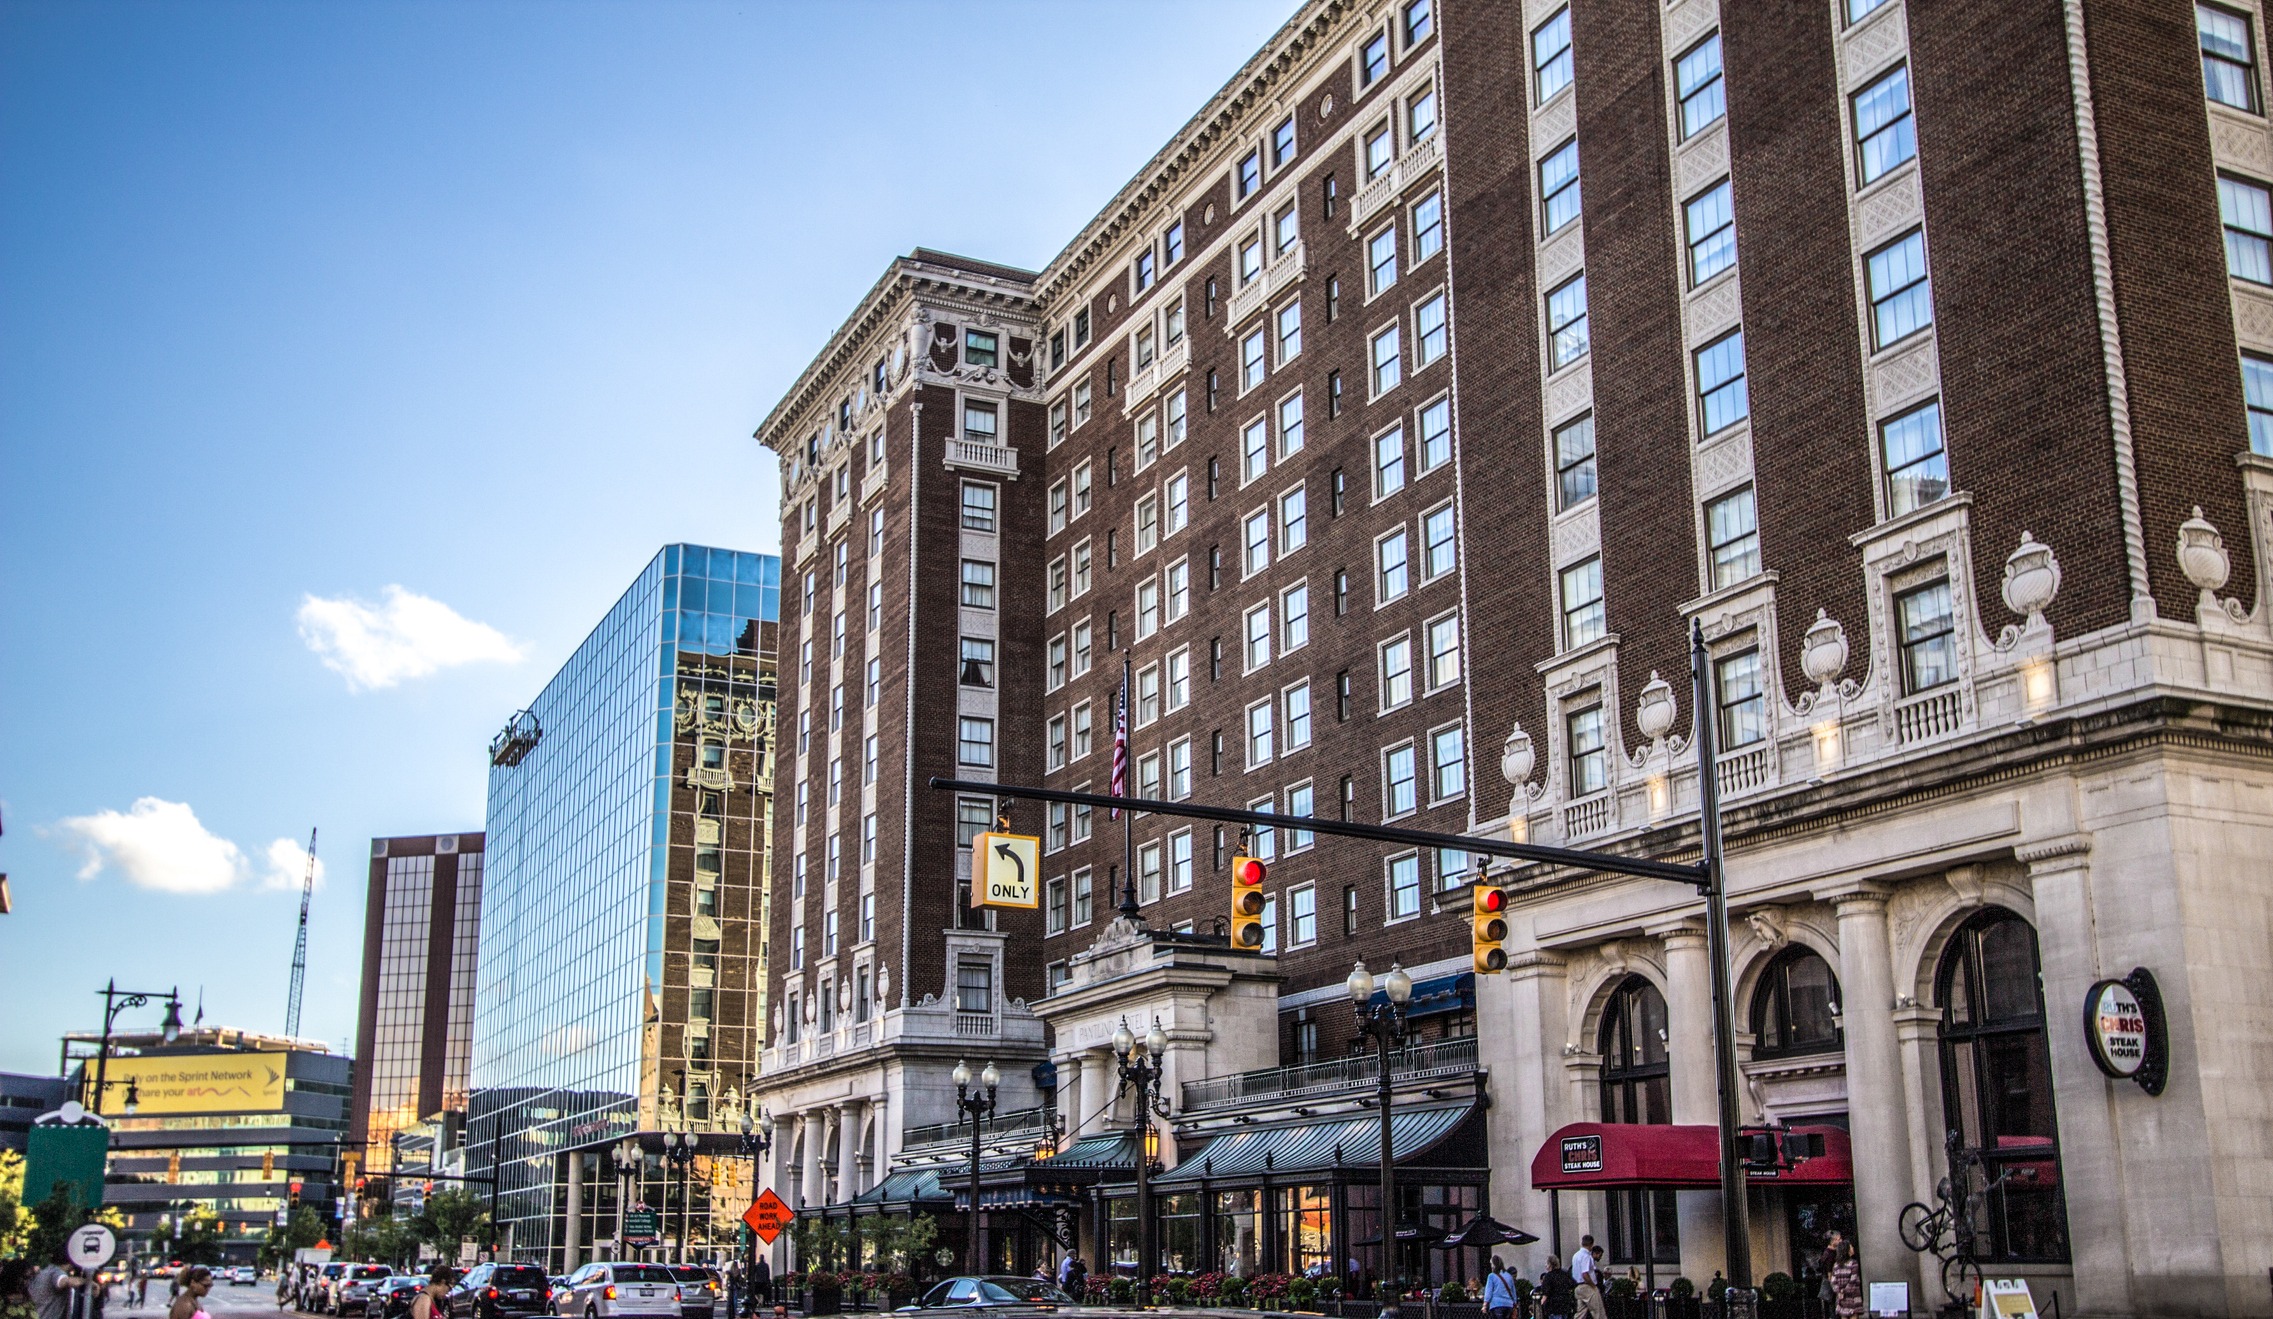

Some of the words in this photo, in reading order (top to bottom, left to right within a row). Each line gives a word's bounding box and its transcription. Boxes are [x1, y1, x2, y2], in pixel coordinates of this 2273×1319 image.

[992, 884, 1029, 899] ONLY
[2102, 1002, 2138, 1013] RUTH'S
[1120, 1013, 1144, 1031] OTEL
[2101, 1016, 2144, 1033] CHRIS
[2110, 1037, 2139, 1047] STEAK
[2110, 1047, 2140, 1058] HOUSE
[146, 1074, 158, 1082] on
[161, 1072, 176, 1082] the
[179, 1070, 208, 1083] Sprint
[211, 1069, 253, 1080] Network
[163, 1088, 184, 1100] your
[187, 1087, 201, 1097] art
[1564, 1142, 1587, 1150] RUTH'S
[1568, 1150, 1598, 1162] CHRIS
[1564, 1162, 1581, 1170] STEAK
[759, 1202, 778, 1210] ROAD
[759, 1212, 778, 1220] WORK
[758, 1222, 781, 1230] AHEAD
